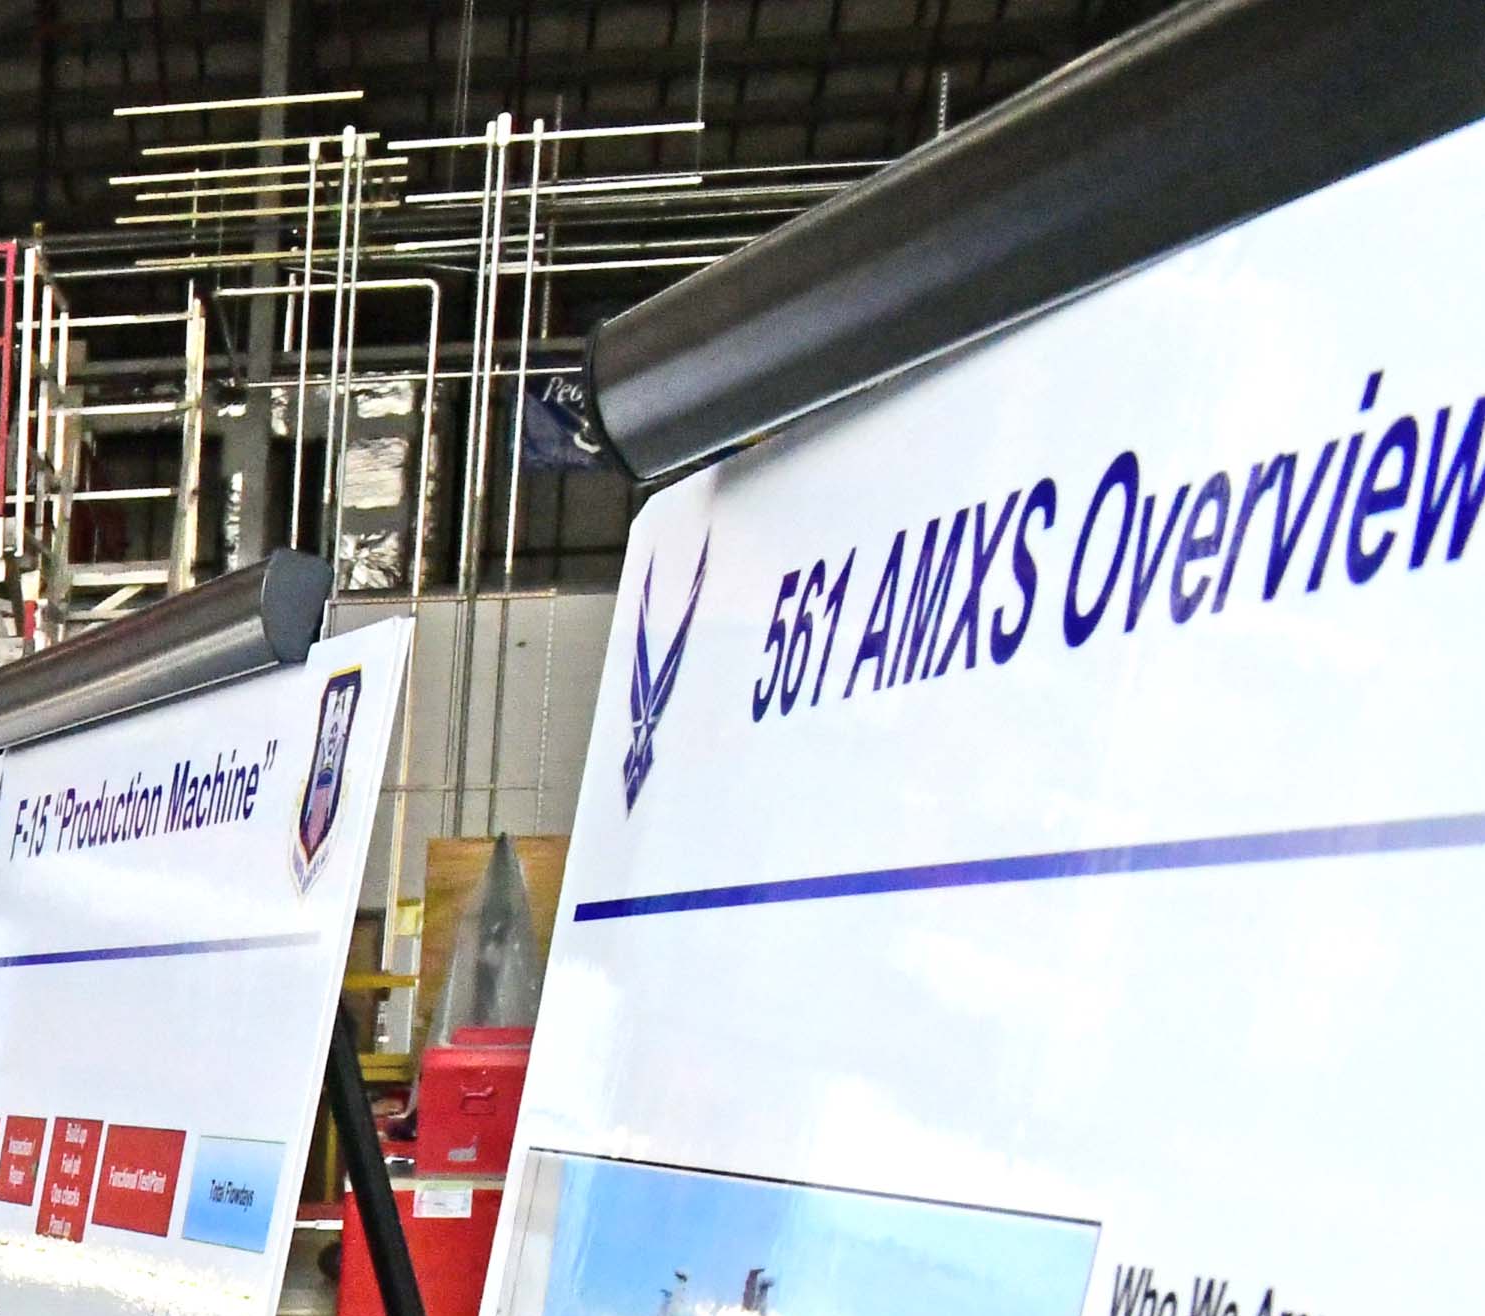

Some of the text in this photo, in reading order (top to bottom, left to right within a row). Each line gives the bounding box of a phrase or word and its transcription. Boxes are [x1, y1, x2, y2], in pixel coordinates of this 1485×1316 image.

[751, 369, 1485, 724] 561 AMXS Overview
[10, 793, 52, 862] F-15
[210, 1178, 226, 1202] Total
